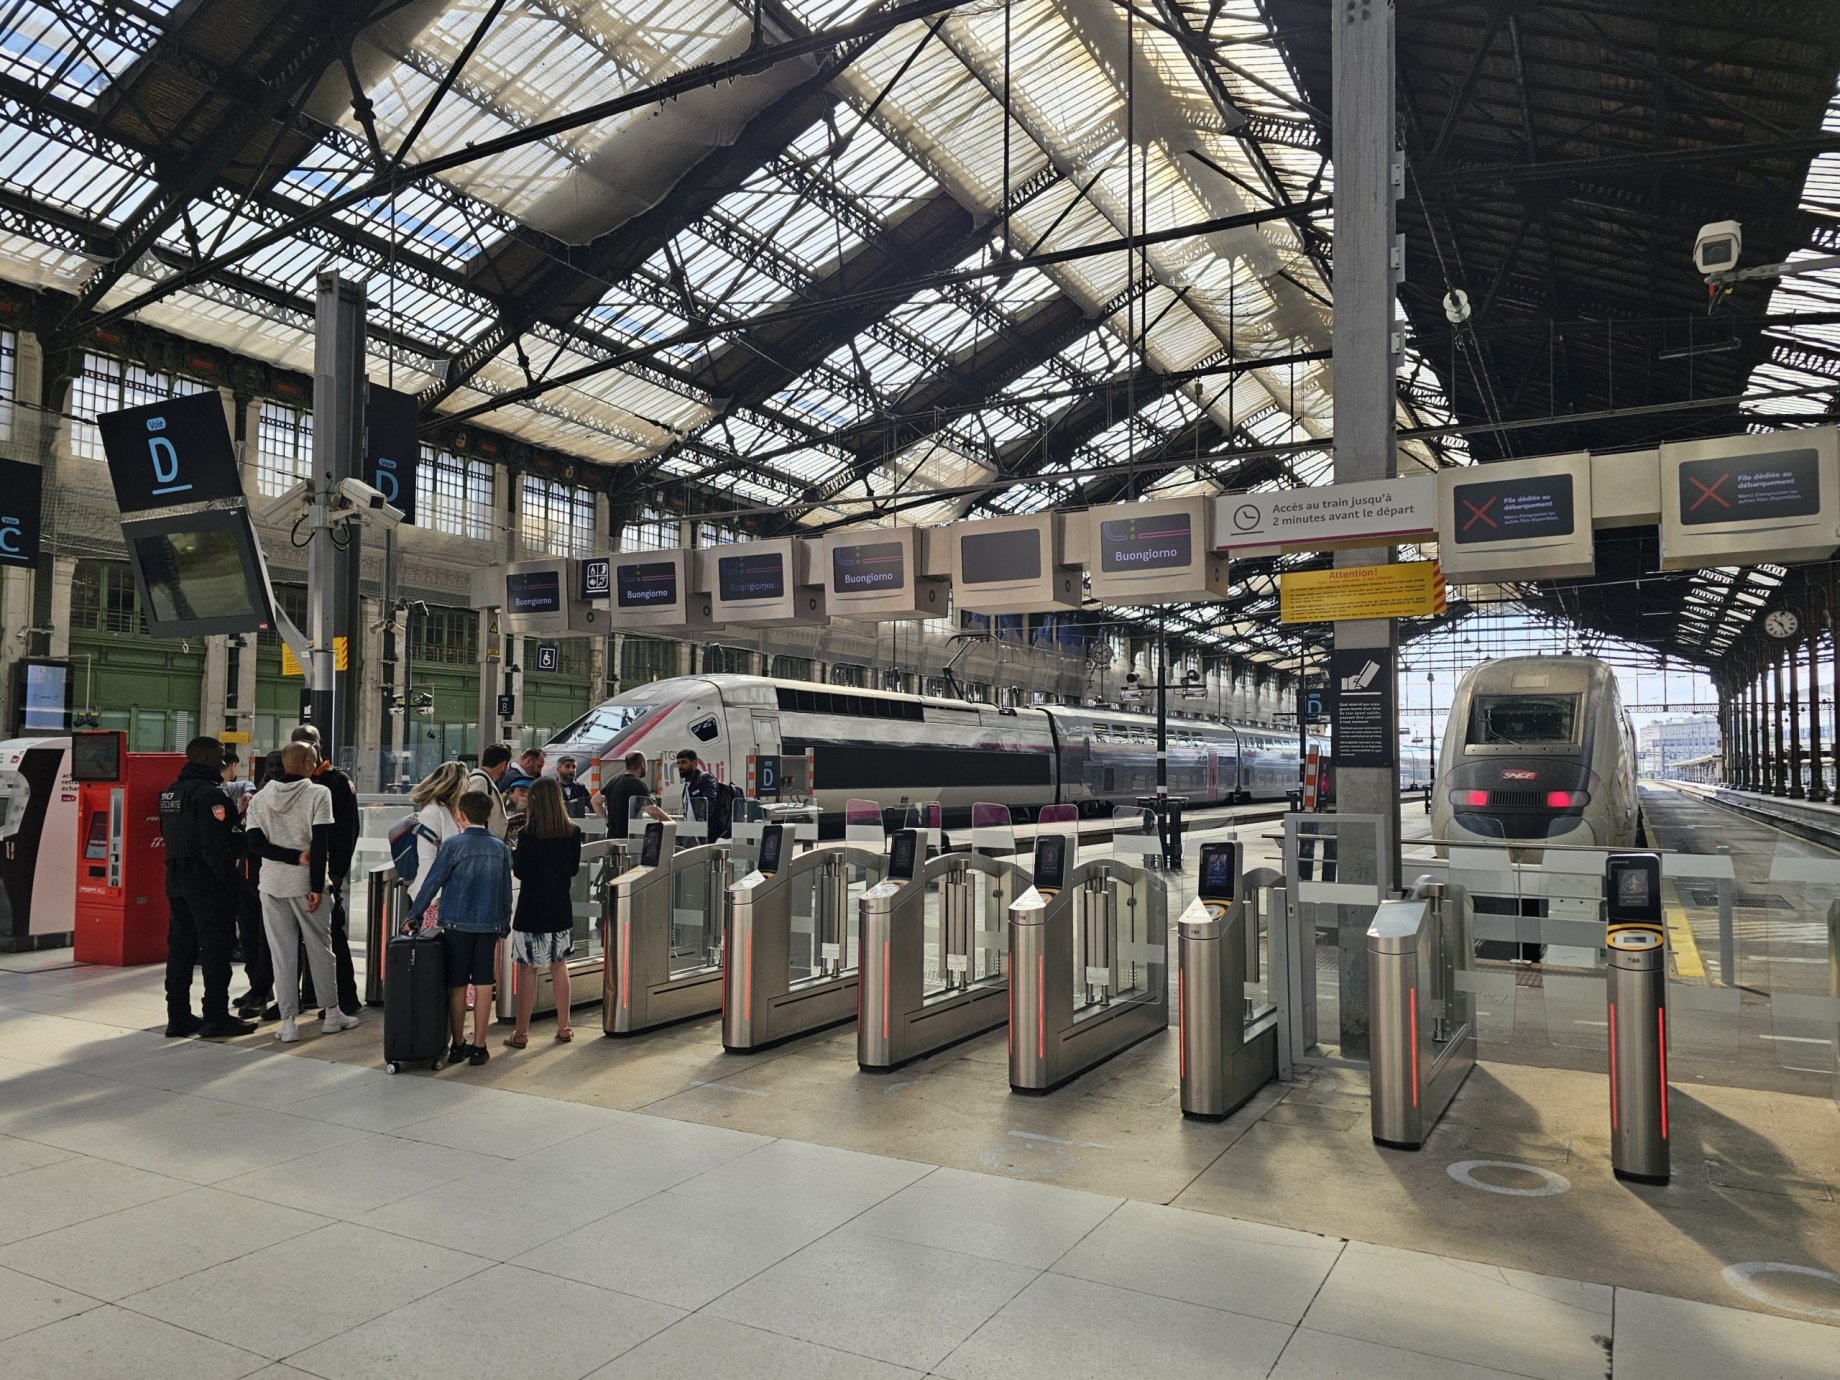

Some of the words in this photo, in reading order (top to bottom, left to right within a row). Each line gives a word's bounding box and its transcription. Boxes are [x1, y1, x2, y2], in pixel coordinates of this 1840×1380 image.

[148, 420, 164, 429] Voie
[148, 436, 178, 483] D
[376, 470, 399, 502] D
[1738, 478, 1795, 489] débarquement
[1273, 502, 1304, 513] Accès
[1306, 502, 1319, 510] au
[1323, 498, 1349, 509] train
[1350, 493, 1392, 508] jusqu'à
[1504, 501, 1553, 510] débarquement
[1273, 517, 1279, 526] 2
[1282, 514, 1326, 525] minutes
[1329, 510, 1360, 521] avant
[1363, 508, 1373, 518] le
[1376, 505, 1415, 518] départ
[0, 527, 21, 552] C
[1115, 548, 1177, 562] Buongiorno
[844, 572, 893, 584] Buongiorno
[1329, 568, 1378, 579] Attention!
[627, 588, 668, 600] Buongiorno
[515, 596, 552, 607] Buongiorno
[1308, 700, 1322, 716] D
[763, 768, 774, 786] D
[1503, 772, 1536, 780] SNCF
